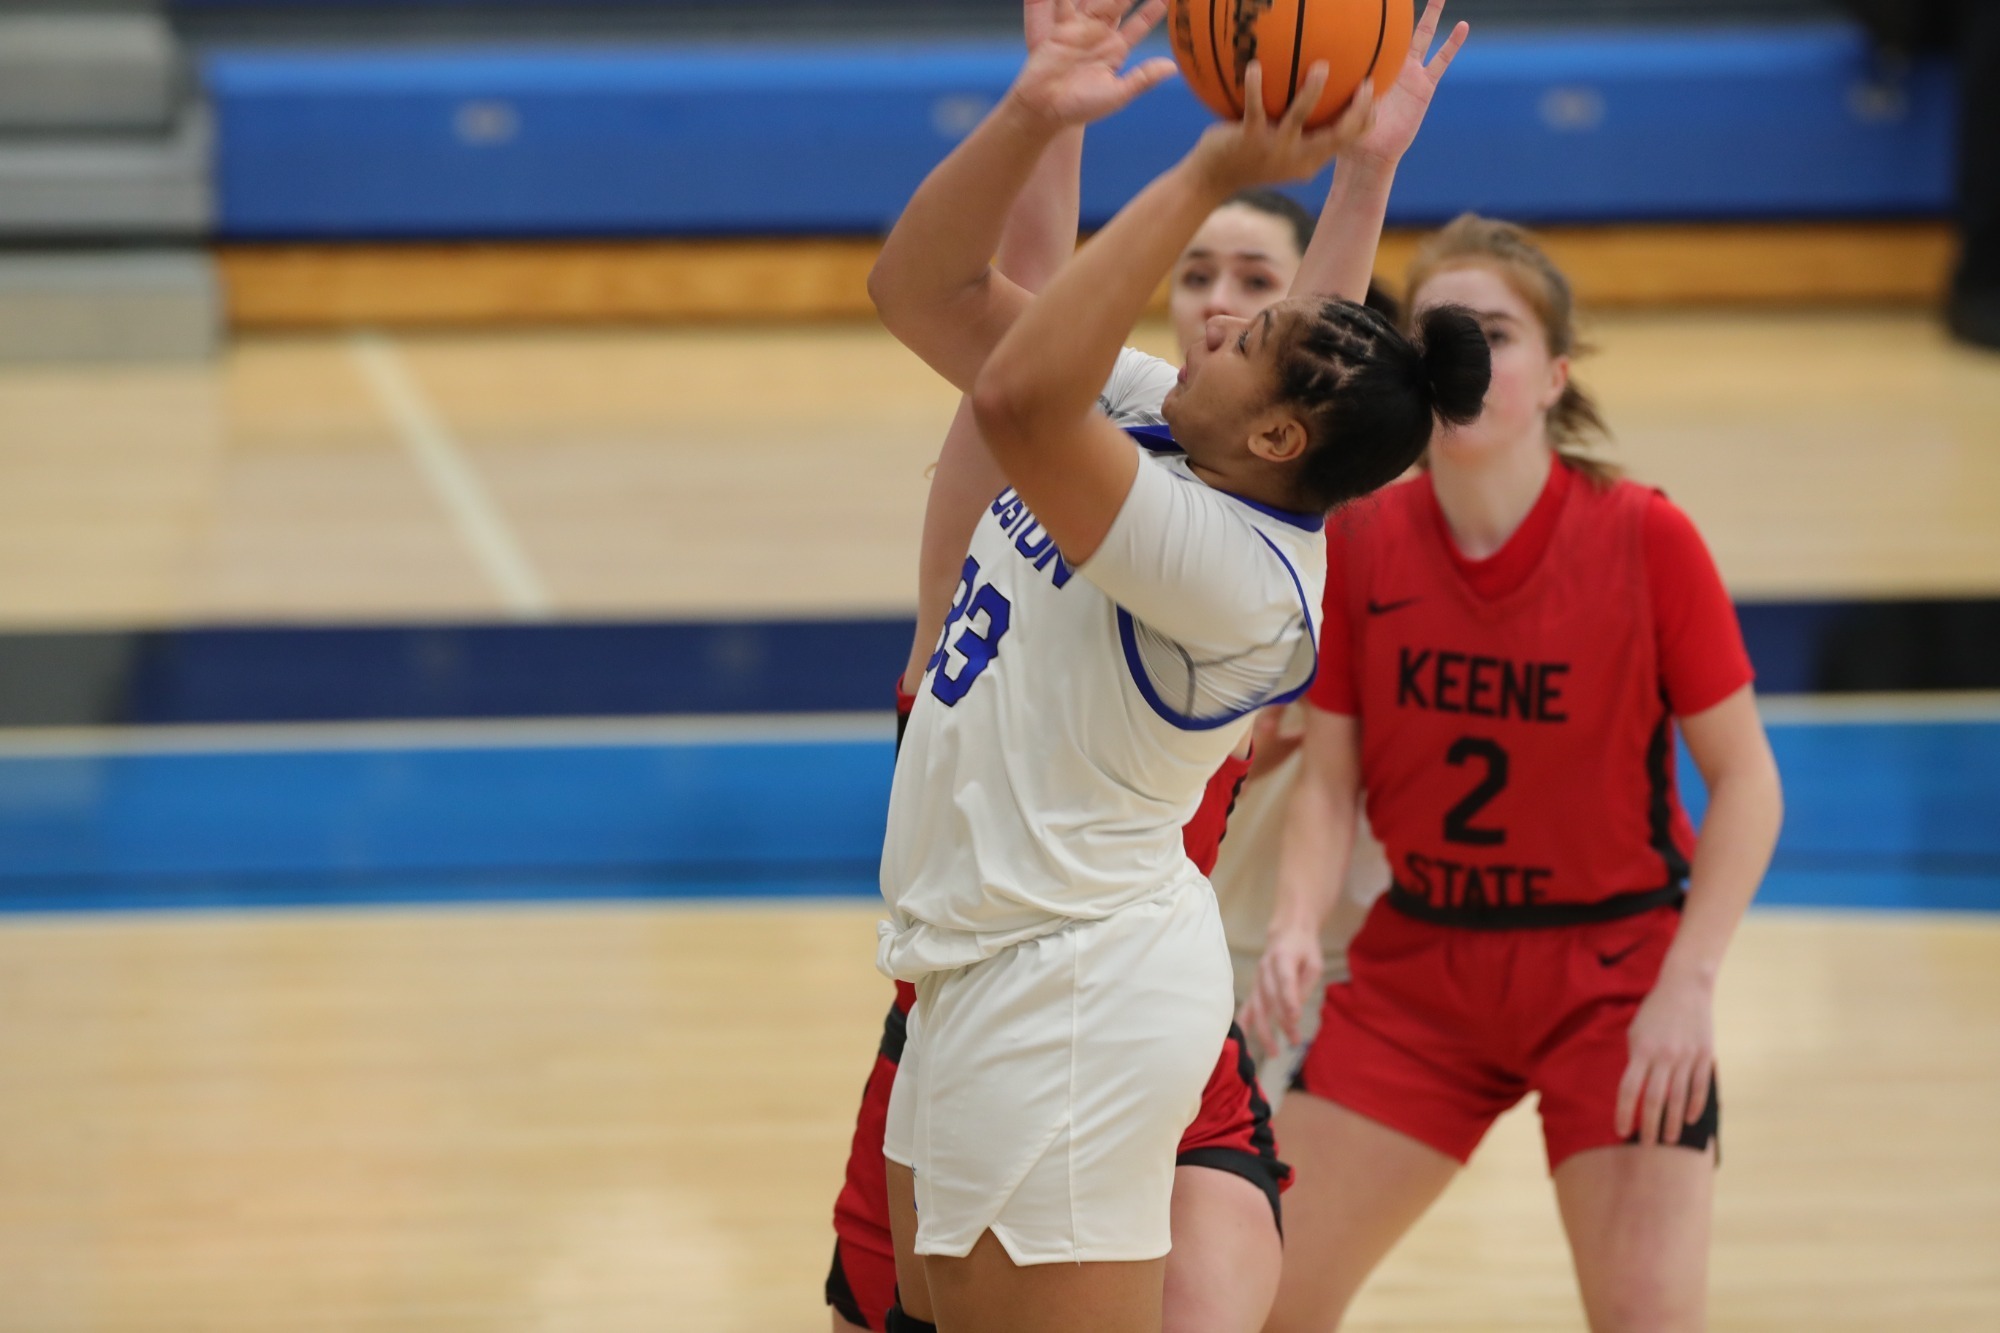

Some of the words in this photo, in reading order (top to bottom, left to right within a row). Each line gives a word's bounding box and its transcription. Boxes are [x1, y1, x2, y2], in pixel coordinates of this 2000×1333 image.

[1398, 647, 1569, 723] KEENE
[1444, 735, 1508, 846] 2
[1405, 853, 1552, 909] STATE
